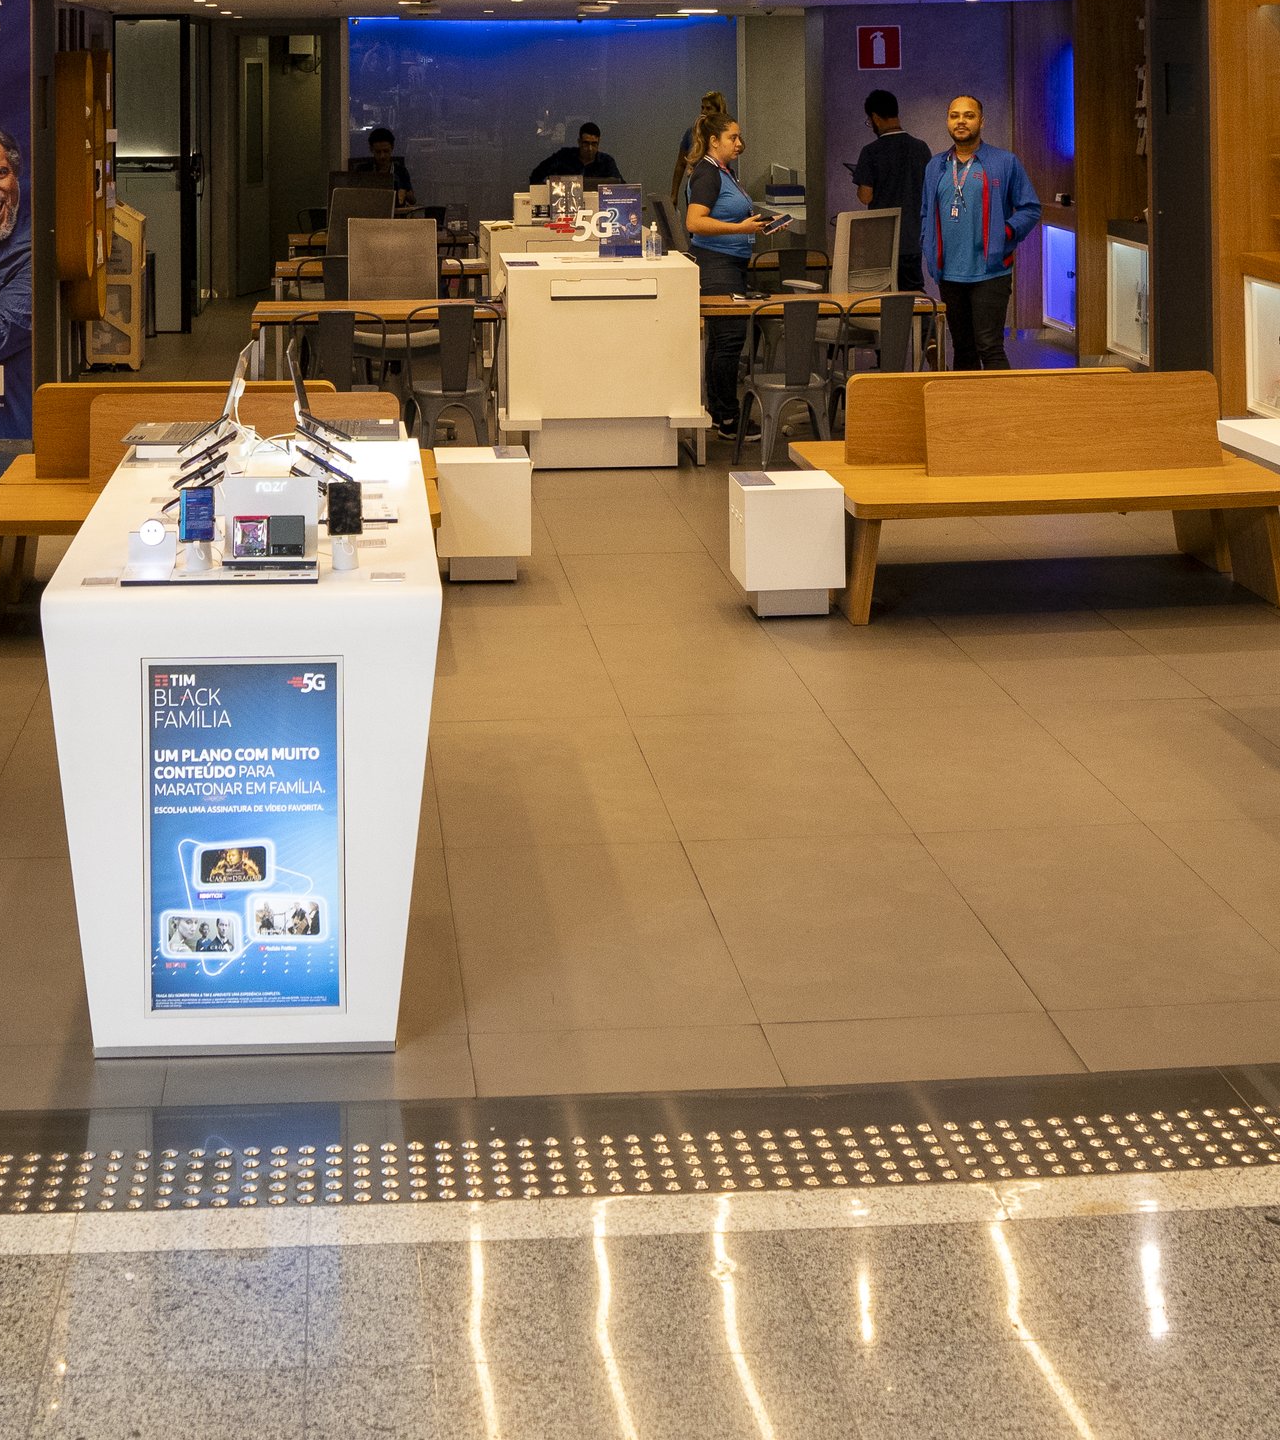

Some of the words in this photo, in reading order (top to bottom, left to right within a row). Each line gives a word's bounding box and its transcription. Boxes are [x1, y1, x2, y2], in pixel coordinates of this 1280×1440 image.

[572, 209, 613, 242] 5G
[255, 481, 288, 493] razr
[170, 674, 195, 687] TIM
[301, 672, 326, 692] 5G
[154, 687, 221, 707] BLACK
[154, 707, 232, 729] FAMÍLIA
[155, 750, 178, 762] UM
[182, 749, 232, 762] PLANO
[235, 748, 268, 761] COM
[272, 748, 319, 760] MUITO
[154, 764, 236, 778] CONTEÚDO
[240, 765, 274, 777] PARA
[155, 783, 242, 795] MARATONAR
[246, 782, 265, 794] EM
[270, 780, 325, 794] FAMÍLIA.
